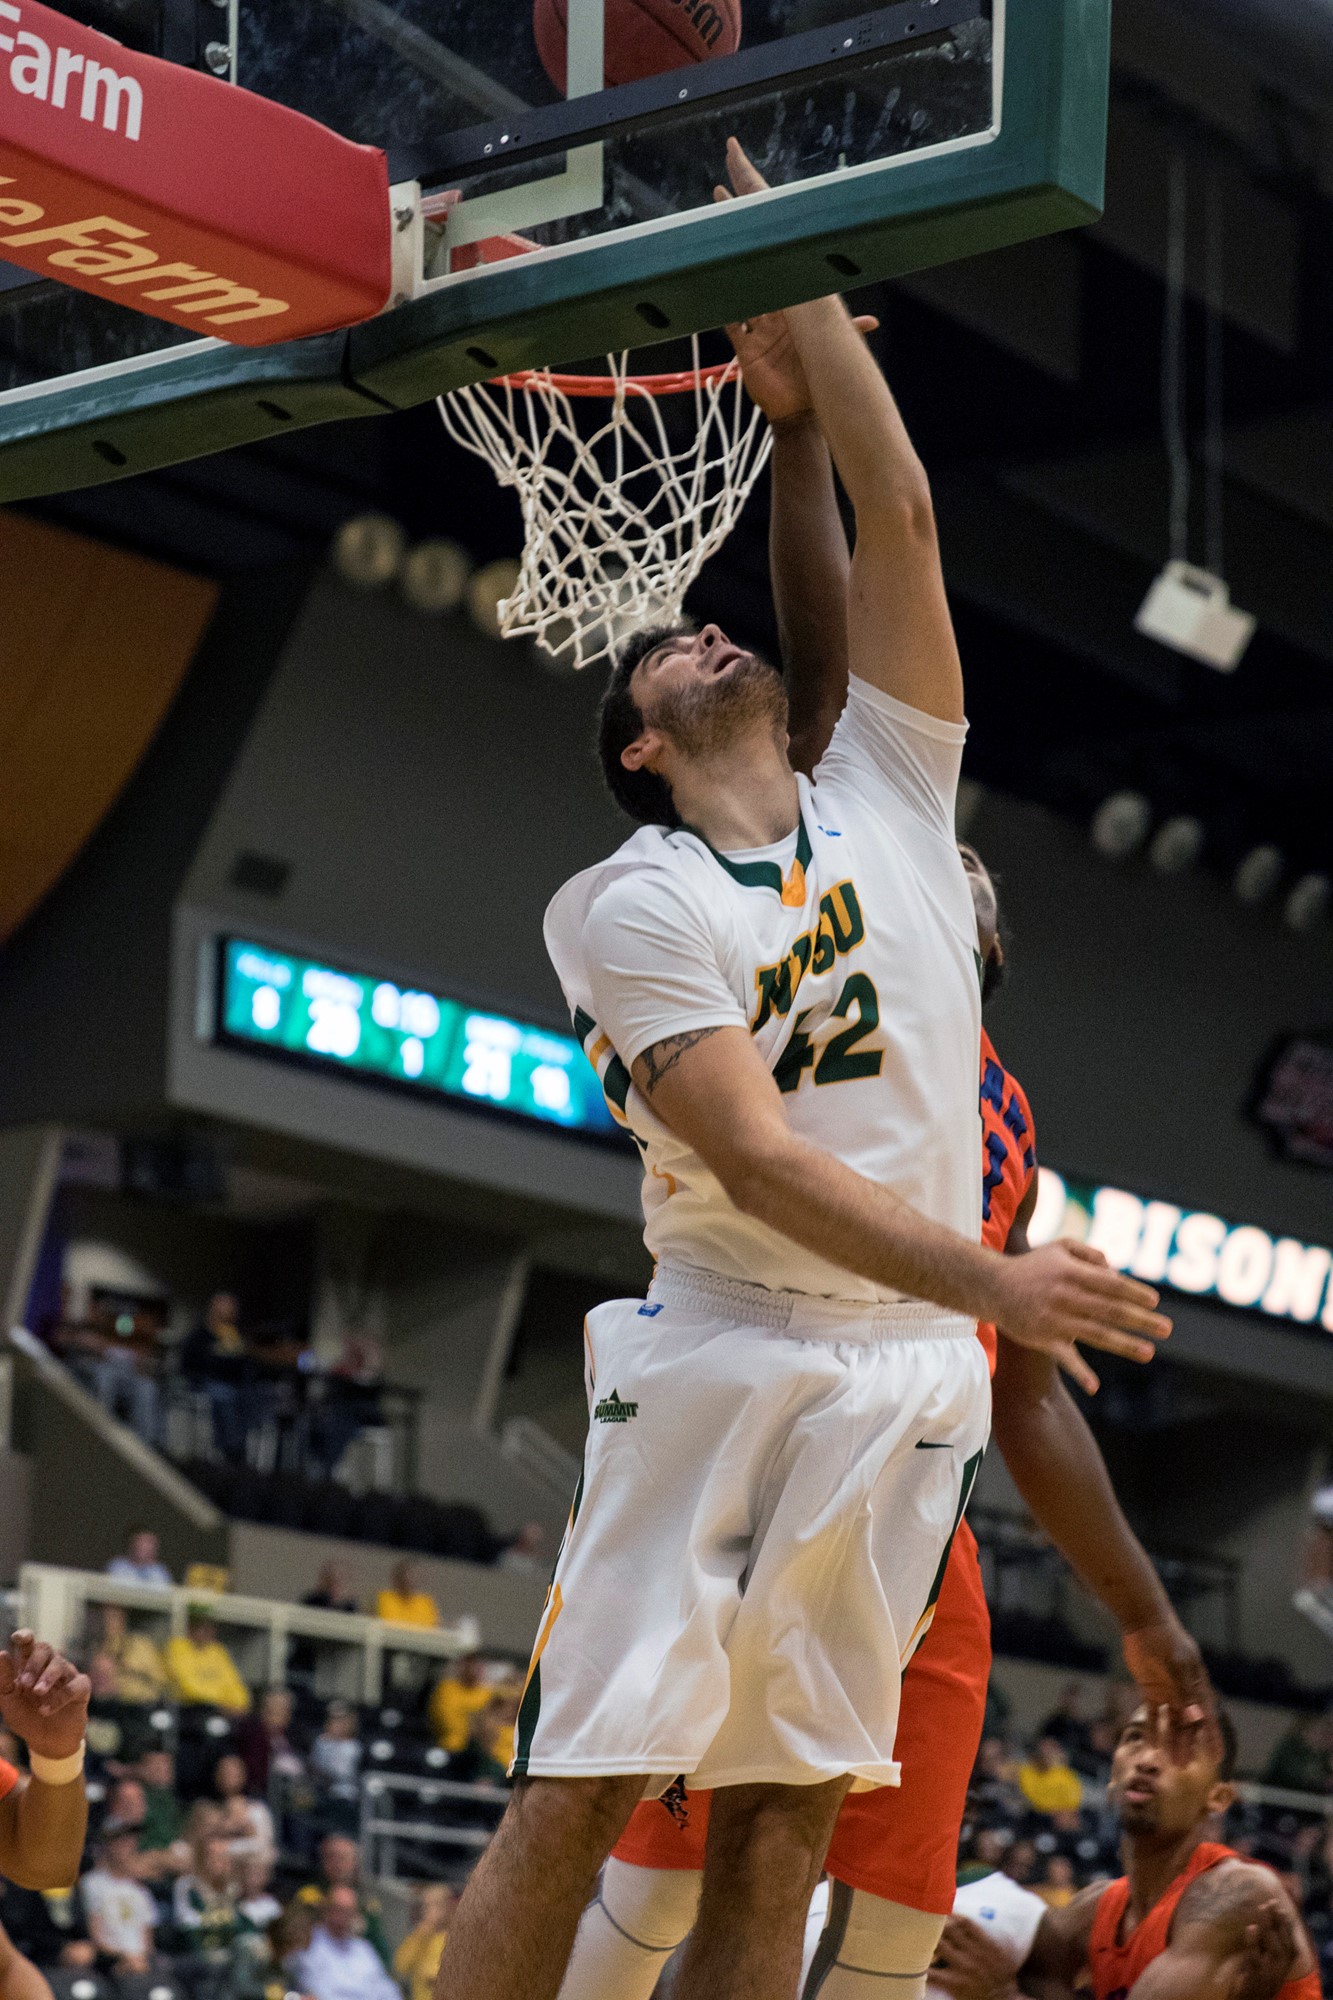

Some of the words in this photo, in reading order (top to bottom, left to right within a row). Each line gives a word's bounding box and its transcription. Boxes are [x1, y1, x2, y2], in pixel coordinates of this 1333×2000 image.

[0, 215, 290, 325] Farm
[768, 971, 886, 1095] 42
[594, 1402, 639, 1420] SUMMIT
